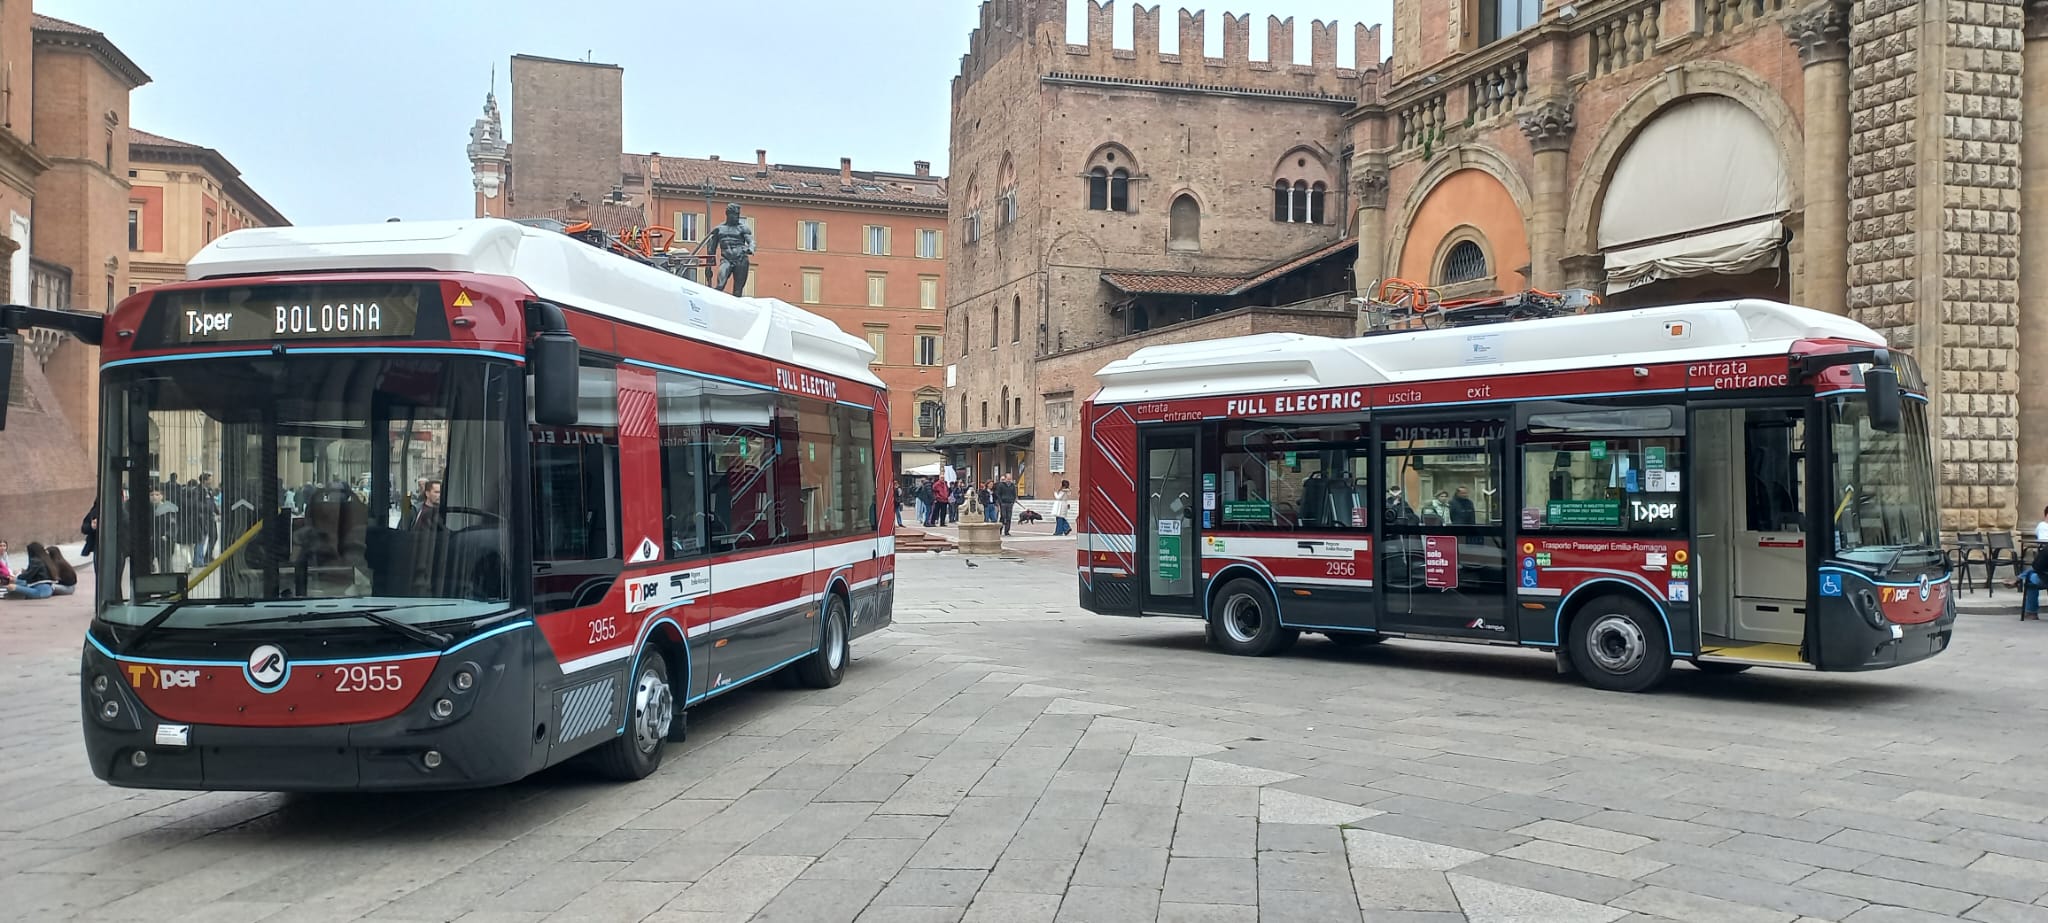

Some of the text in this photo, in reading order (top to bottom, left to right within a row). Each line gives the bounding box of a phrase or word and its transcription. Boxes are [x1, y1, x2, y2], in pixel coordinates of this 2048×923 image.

[275, 303, 380, 333] BOLOGNA
[1689, 361, 1747, 376] entrata
[776, 368, 837, 399] FULL ELECTRIC
[1714, 374, 1787, 389] entrance
[1388, 384, 1490, 403] uscita exit
[1137, 402, 1169, 414] entrata
[1227, 391, 1362, 416] FULL ELECTRIC
[1163, 411, 1202, 422] entrance
[1427, 550, 1442, 558] solo
[1542, 541, 1667, 553] Trasporto Passeggeri Emilia-Romagna
[1326, 561, 1355, 576] 2956
[588, 616, 616, 644] 2955
[334, 665, 402, 692] 2955
